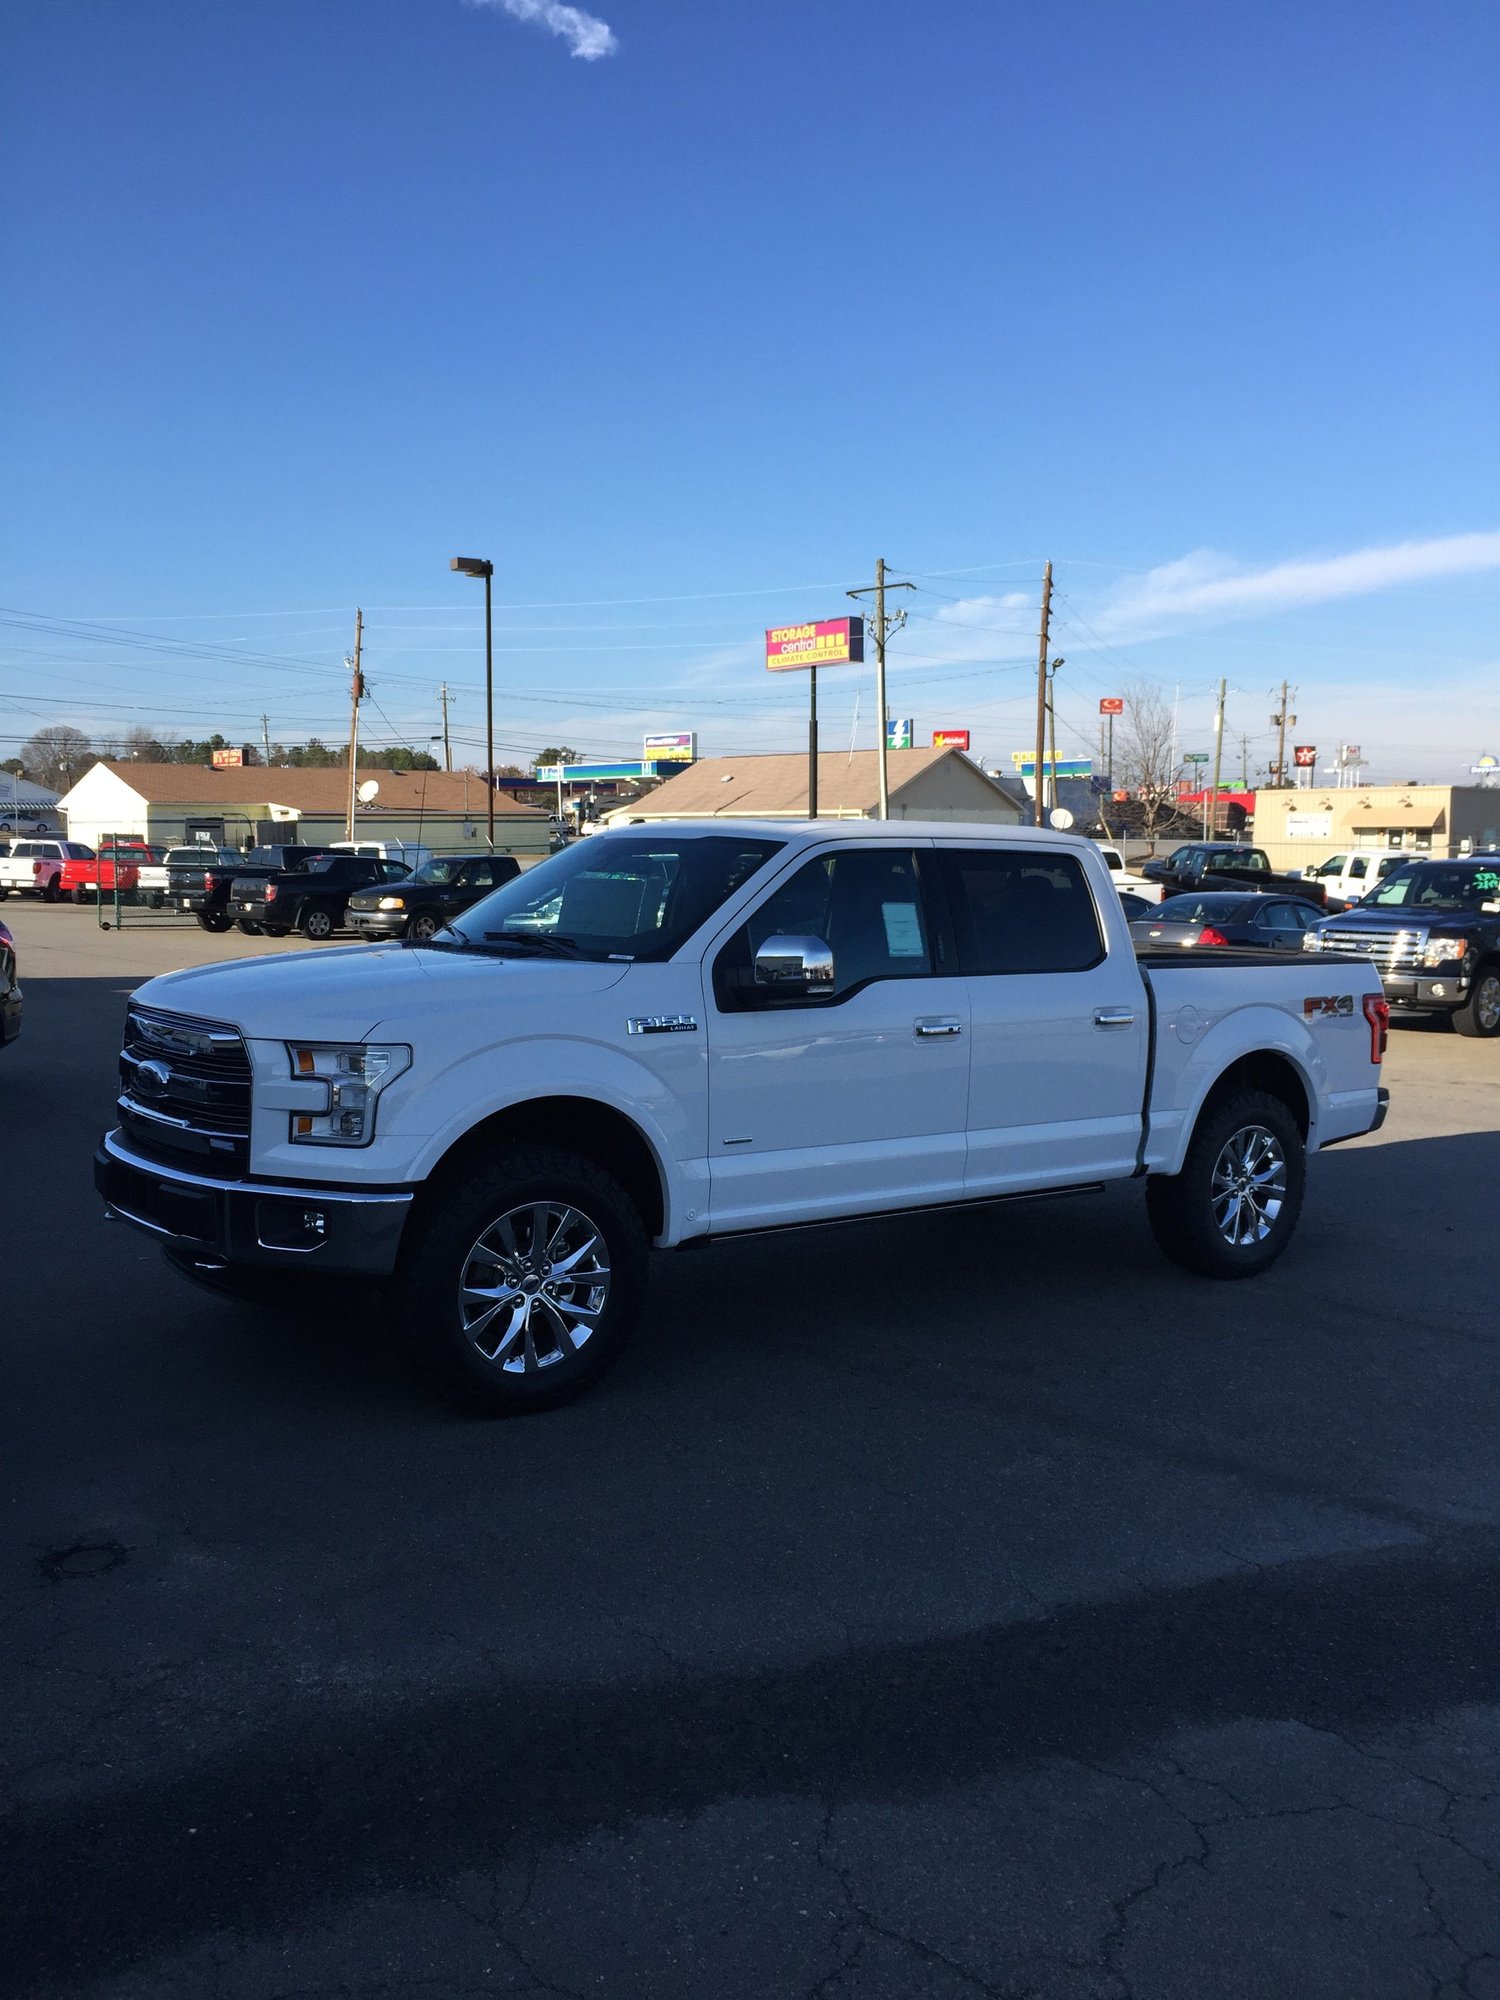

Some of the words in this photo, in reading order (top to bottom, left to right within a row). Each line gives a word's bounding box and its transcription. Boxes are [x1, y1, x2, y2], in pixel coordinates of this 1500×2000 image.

[771, 624, 816, 643] STORAGE
[781, 637, 816, 654] central
[771, 654, 804, 665] CLIMATE
[806, 648, 844, 660] CONTROL
[1304, 995, 1353, 1018] FX4
